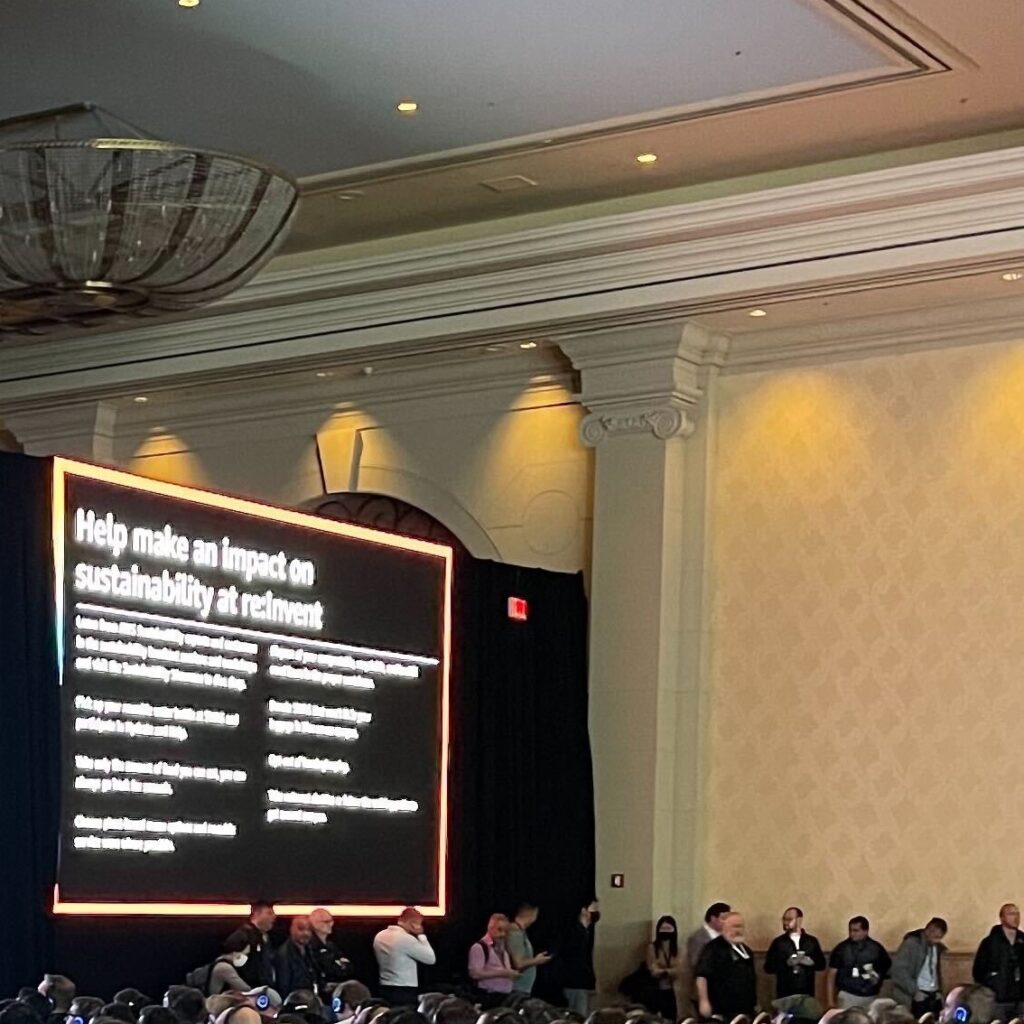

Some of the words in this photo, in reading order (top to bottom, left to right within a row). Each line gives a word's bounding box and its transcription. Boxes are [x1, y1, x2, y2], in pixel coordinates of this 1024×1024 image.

[75, 508, 128, 556] Help
[132, 524, 190, 562] make
[192, 539, 218, 569] an
[221, 537, 288, 581] impact
[290, 557, 316, 586] on
[75, 563, 215, 619] sustainability
[217, 586, 239, 616] at
